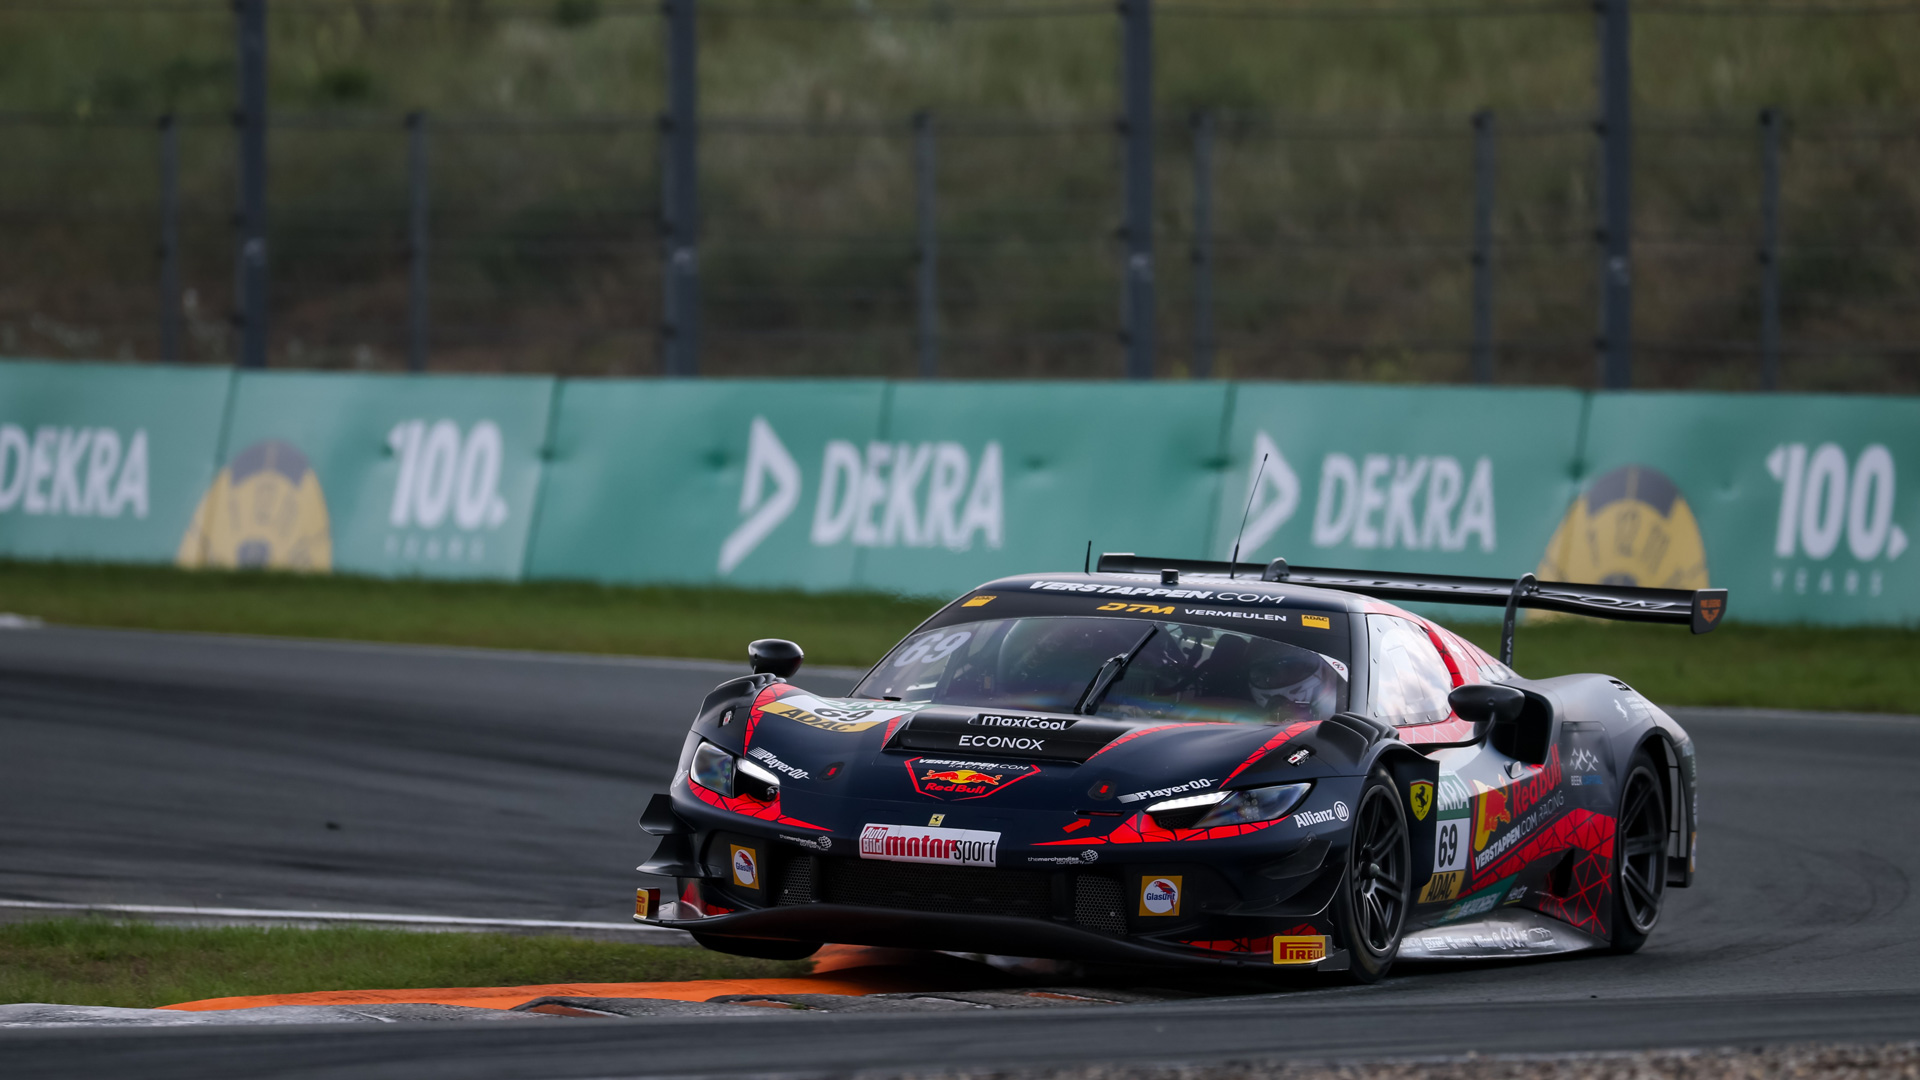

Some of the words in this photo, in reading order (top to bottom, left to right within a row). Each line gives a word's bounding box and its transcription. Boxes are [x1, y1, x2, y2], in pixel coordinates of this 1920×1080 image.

[0, 423, 149, 520] DEKRA
[811, 438, 1003, 551] DEKRA
[1311, 452, 1497, 553] DEKRA
[1029, 580, 1286, 605] VERSTAPPEN.COM
[1096, 602, 1175, 615] DTM
[1184, 608, 1287, 622] VERMEULEN
[1303, 614, 1328, 623] ADAC
[893, 631, 972, 668] 69
[778, 707, 857, 732] ADAC
[814, 707, 874, 722] 69
[958, 734, 1046, 751] ECONOX
[919, 758, 1030, 771] VERSTAPPEN.COM
[924, 782, 955, 792] Red
[955, 784, 987, 795] Bull
[1135, 784, 1189, 800] Player
[1511, 764, 1539, 819] Red
[1293, 808, 1336, 829] Allianz
[862, 827, 885, 839] Auto
[1475, 812, 1538, 871] VERSTAPPEN.COM
[863, 838, 883, 854] Bild
[1438, 823, 1458, 868] 69
[1424, 872, 1457, 902] ADAC
